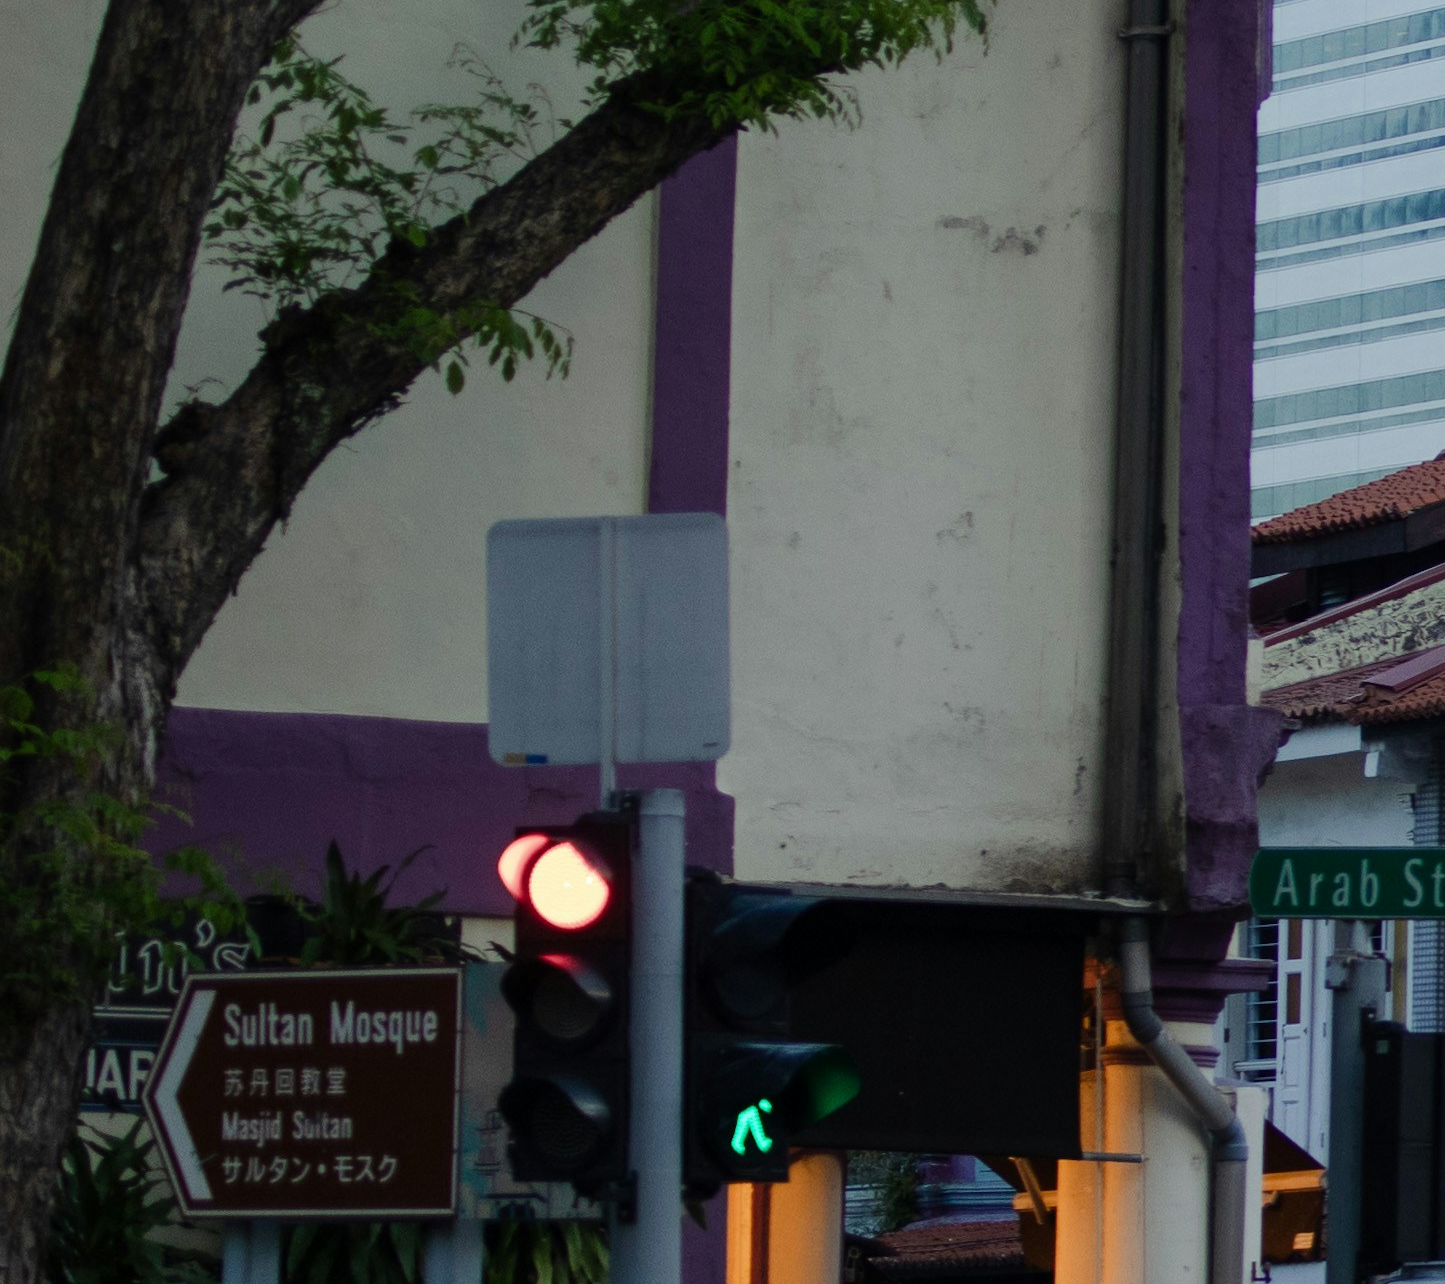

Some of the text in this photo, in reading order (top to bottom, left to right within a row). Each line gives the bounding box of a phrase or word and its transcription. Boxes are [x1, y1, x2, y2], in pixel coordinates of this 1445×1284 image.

[1273, 858, 1379, 907] Arab
[224, 1000, 438, 1055] Sultan Mosque
[223, 1067, 347, 1096] 苏丹回教堂
[222, 1110, 353, 1148] Masjid Sultan
[222, 1155, 398, 1183] サルタン・モスク
